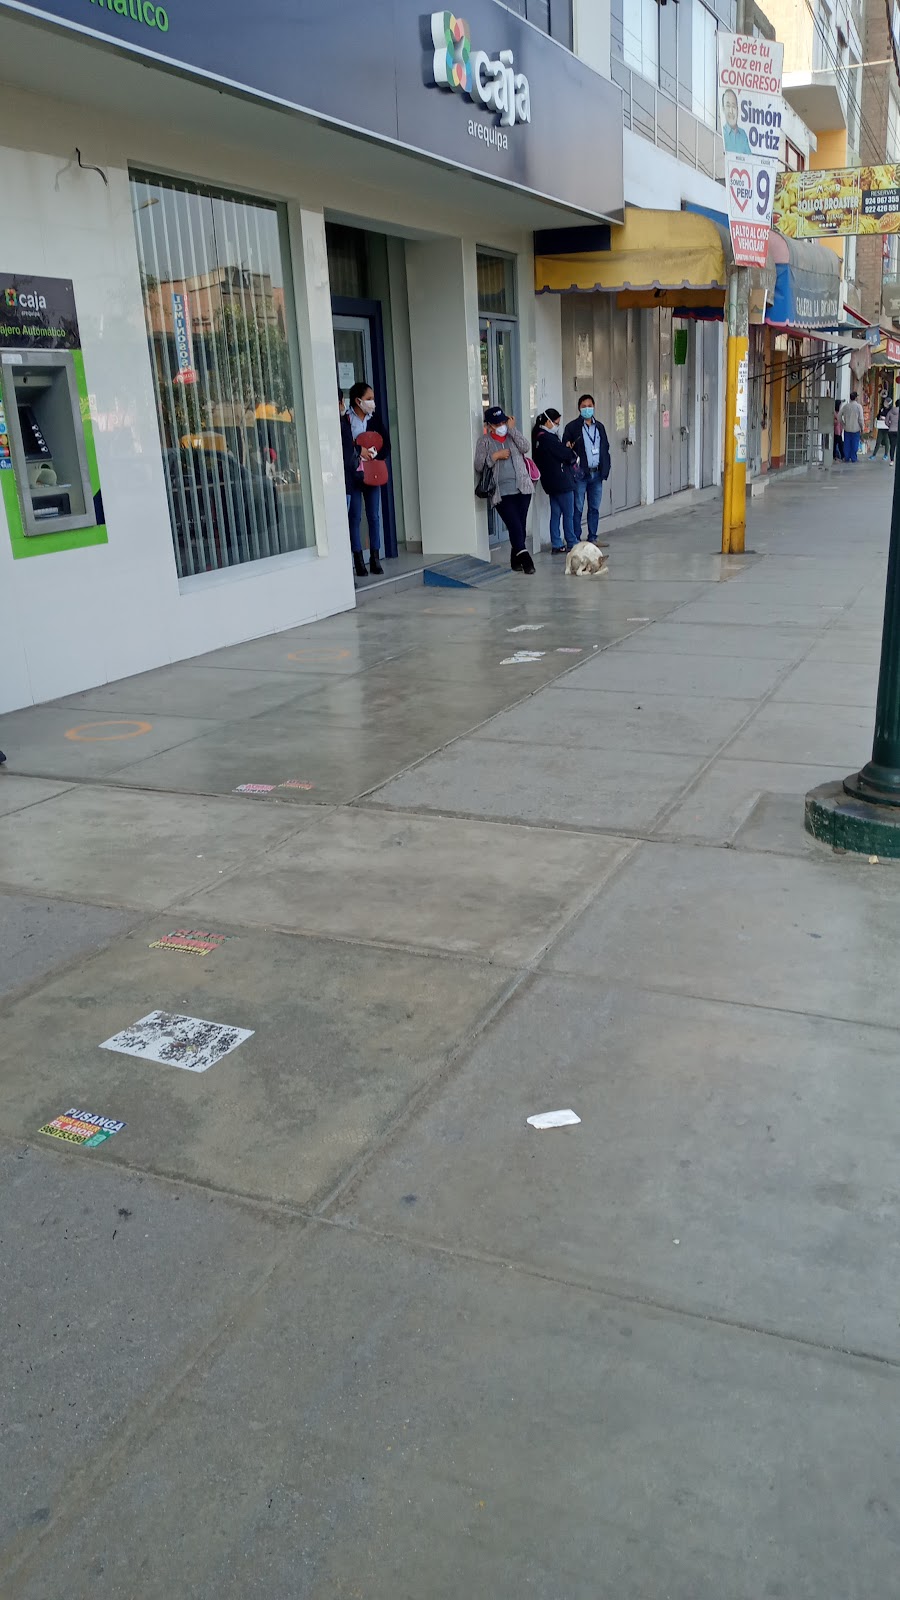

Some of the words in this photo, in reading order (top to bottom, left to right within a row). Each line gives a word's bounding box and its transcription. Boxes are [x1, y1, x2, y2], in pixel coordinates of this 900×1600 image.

[732, 37, 757, 57] ¡Seré
[760, 42, 770, 58] tu
[730, 56, 748, 70] voz
[749, 60, 761, 71] en
[763, 59, 773, 75] el
[471, 50, 531, 126] caja
[720, 69, 781, 93] CONGRESO!
[740, 100, 782, 128] Simón
[468, 119, 508, 151] arequipa
[749, 126, 780, 151] Ortiz
[756, 169, 770, 216] 9
[870, 189, 897, 197] RESERVAS
[797, 198, 823, 212] POLLOS
[824, 196, 859, 211] BROASTER
[750, 226, 756, 239] AL
[756, 227, 769, 240] CAOS
[19, 290, 47, 311] caja
[22, 324, 66, 337] Automático
[49, 1119, 62, 1128] EL
[63, 1124, 94, 1137] AMOR
[63, 1107, 124, 1132] PUSANGA
